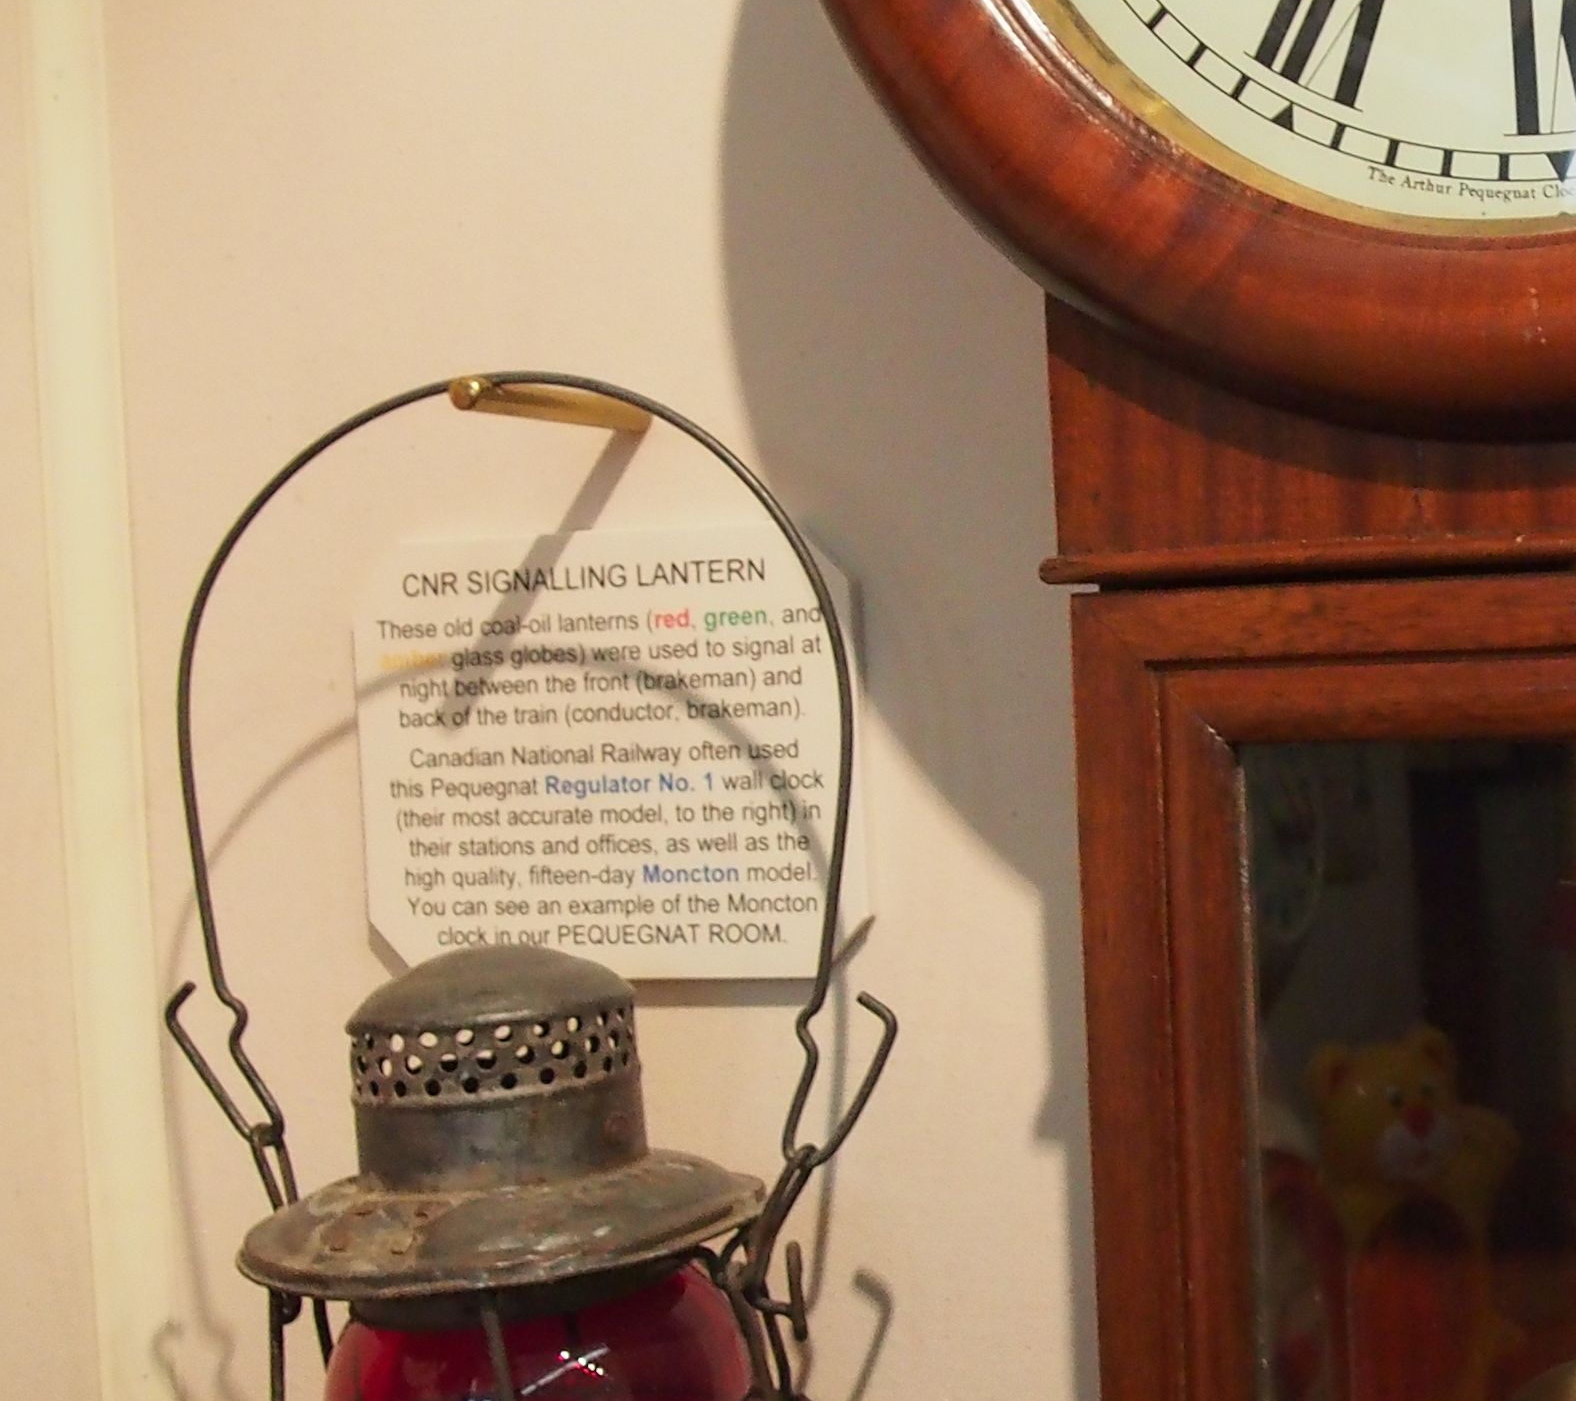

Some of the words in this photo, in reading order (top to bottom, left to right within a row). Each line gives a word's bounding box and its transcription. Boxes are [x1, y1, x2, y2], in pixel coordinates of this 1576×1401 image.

[1368, 166, 1395, 185] The
[1401, 175, 1451, 195] Arthur
[1459, 182, 1536, 202] Pequegnat
[403, 572, 458, 597] CNR
[467, 565, 627, 595] SIGNALLING
[637, 558, 766, 586] LANTERN
[377, 619, 437, 639] These
[444, 618, 473, 637] old
[480, 614, 551, 636] coal-oil
[558, 613, 640, 633] lanterns
[647, 608, 696, 633] (red,
[704, 609, 774, 632] green,
[782, 605, 822, 624] and
[452, 647, 504, 670] glass
[509, 643, 586, 669] globes)
[592, 644, 641, 662] were
[649, 639, 698, 660] used
[706, 639, 725, 658] to
[732, 636, 794, 661] signal
[802, 636, 821, 654] at
[400, 679, 449, 701] night
[454, 677, 538, 697] between
[545, 675, 577, 693] the
[584, 671, 629, 692] front
[636, 667, 756, 695] (brakeman)
[763, 666, 802, 686] and
[399, 708, 447, 728] back
[452, 705, 471, 726] of
[477, 707, 508, 726] the
[514, 705, 558, 724] train
[565, 702, 679, 728] (conductor,
[410, 747, 504, 768] Canadian
[512, 744, 594, 765] National
[601, 742, 681, 766] Railway
[689, 740, 741, 760] often
[748, 739, 799, 759] used
[390, 778, 424, 799] this
[431, 777, 538, 801] Pequegnat
[545, 774, 651, 799] Regulator
[659, 772, 695, 792] No.
[704, 772, 714, 790] 1
[721, 771, 763, 790] wall
[769, 770, 825, 790] clock
[396, 807, 445, 831] (their
[452, 808, 500, 827] most
[507, 806, 593, 826] accurate
[600, 804, 668, 825] model,
[676, 804, 695, 823] to
[702, 803, 735, 822] the
[742, 799, 796, 826] right)
[802, 799, 822, 819] in
[409, 838, 452, 858] their
[458, 836, 535, 856] stations
[542, 836, 579, 855] and
[586, 833, 658, 855] offices,
[666, 837, 690, 853] as
[697, 832, 738, 851] well
[745, 836, 769, 851] as
[777, 831, 810, 850] the
[404, 867, 445, 891] high
[452, 866, 522, 890] quality,
[529, 863, 636, 889] fifteen-day
[643, 863, 739, 883] Moncton
[407, 897, 446, 916] You
[452, 899, 488, 915] can
[494, 899, 530, 915] see
[537, 899, 561, 914] an
[568, 895, 655, 918] example
[661, 894, 680, 913] of
[688, 894, 720, 913] the
[728, 892, 818, 913] Moncton
[437, 926, 486, 945] clock
[494, 926, 511, 945] in
[518, 928, 550, 945] our
[557, 923, 700, 945] PEQUEGNAT
[709, 923, 787, 943] ROOM.
